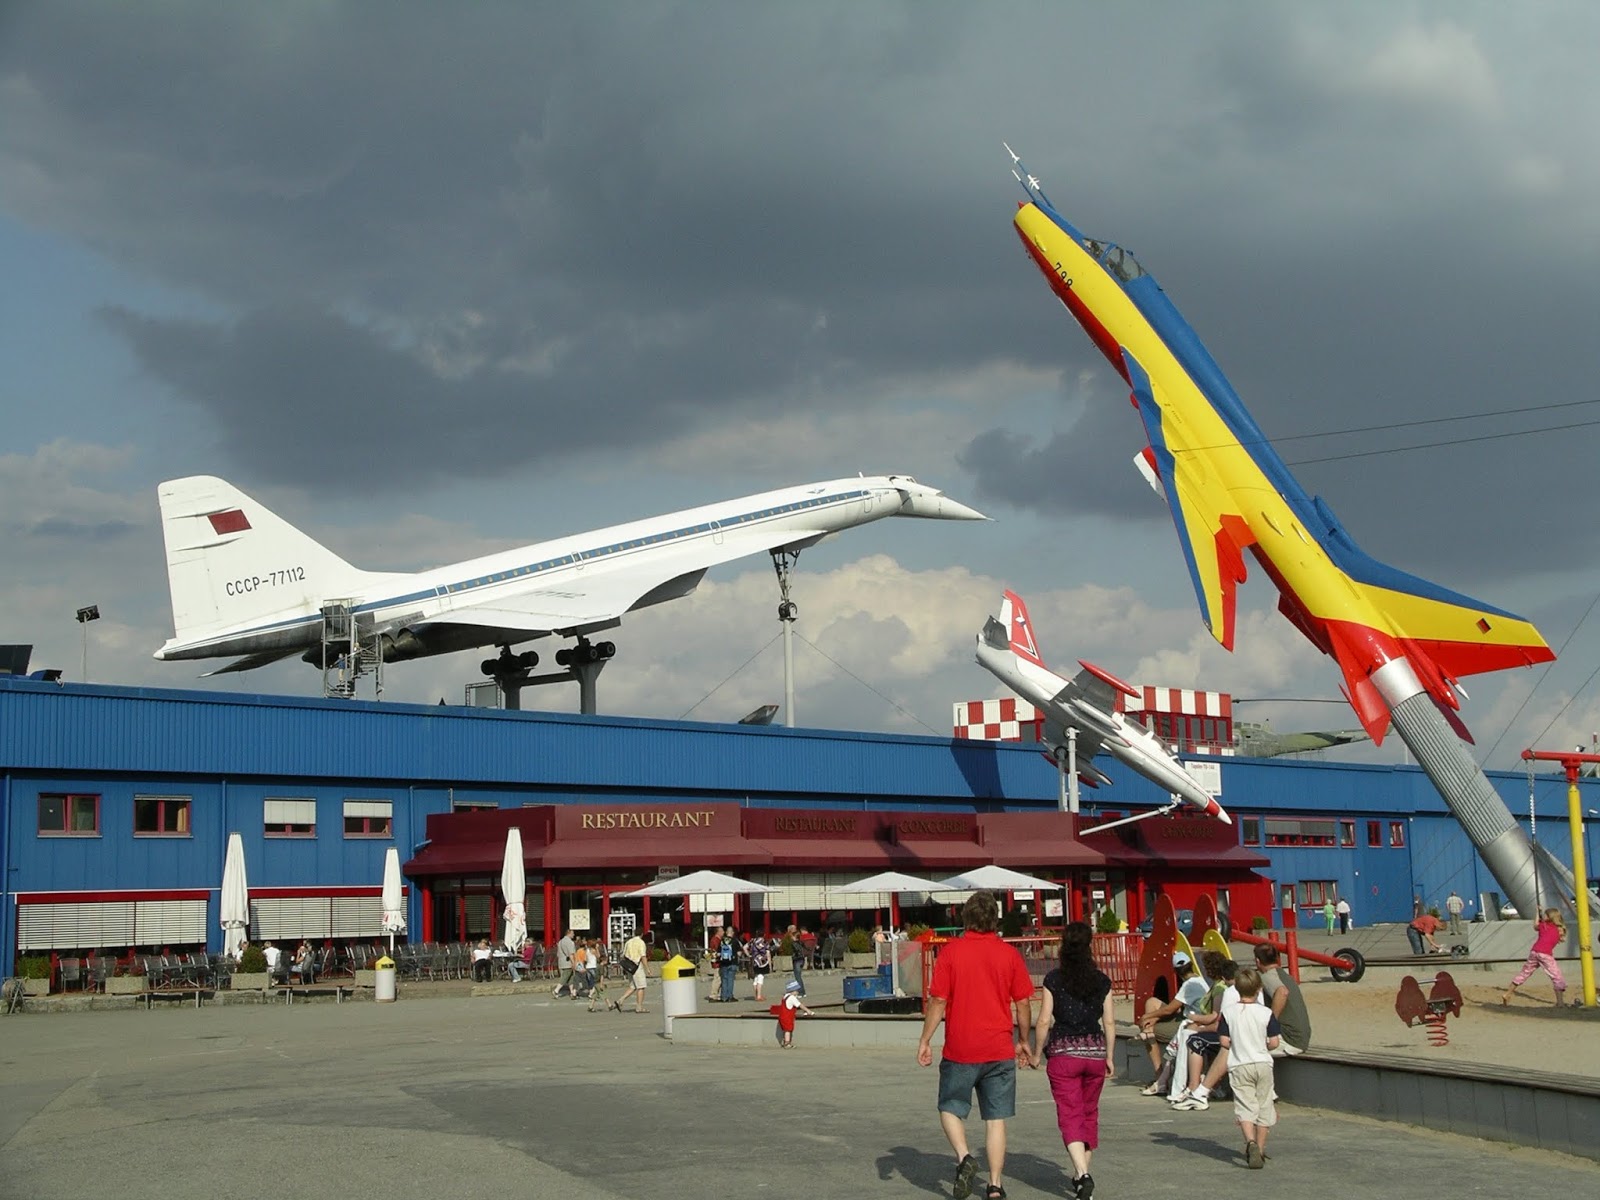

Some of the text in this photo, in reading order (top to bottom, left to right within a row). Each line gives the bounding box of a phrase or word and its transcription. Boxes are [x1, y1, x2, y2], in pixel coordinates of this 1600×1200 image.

[226, 566, 306, 596] CCCP-77112
[581, 811, 715, 829] RESTAURANT
[774, 817, 857, 832] RESTAURANT
